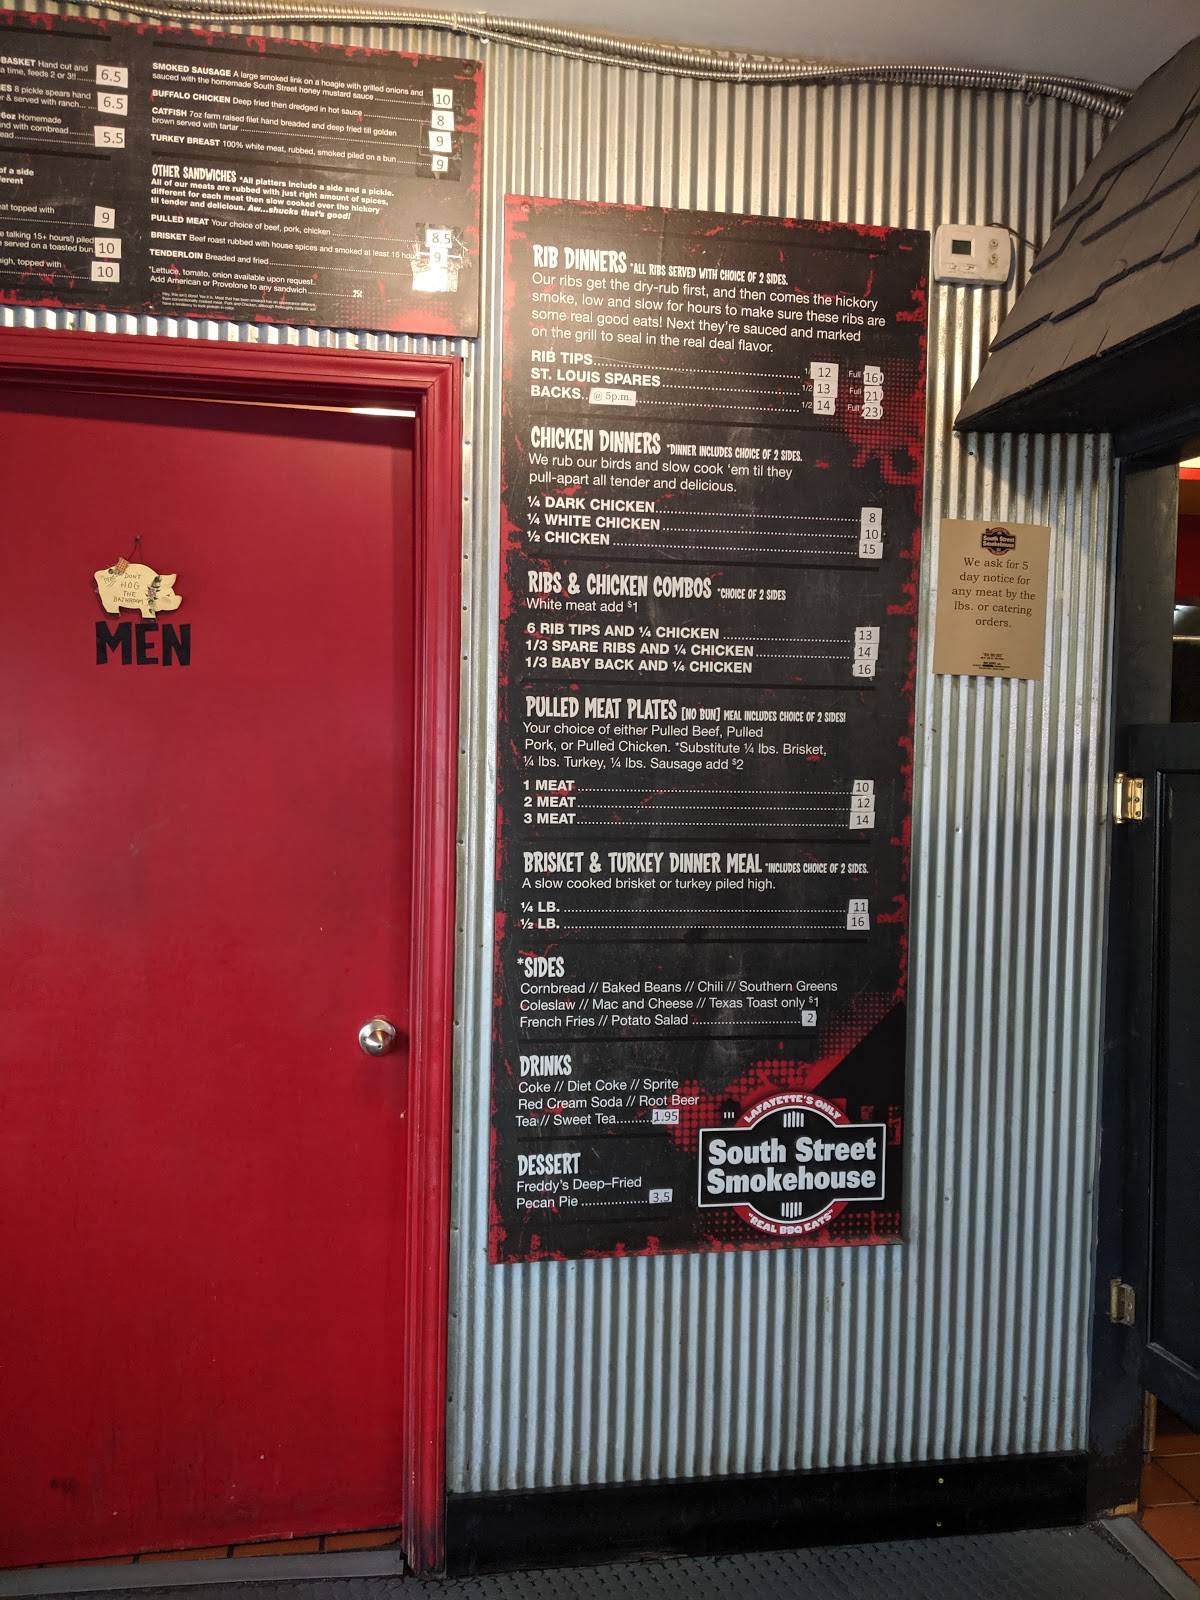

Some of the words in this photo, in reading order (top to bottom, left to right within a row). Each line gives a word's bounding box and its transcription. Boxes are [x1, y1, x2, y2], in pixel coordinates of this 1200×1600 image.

[101, 71, 121, 83] 6.5
[153, 63, 189, 72] SMOKED
[192, 66, 231, 77] SAUSAGE
[241, 71, 258, 80] large
[260, 74, 288, 82] smoked
[322, 80, 344, 89] hoagie
[346, 82, 361, 90] with
[363, 83, 384, 93] grilled
[386, 86, 408, 94] onions
[104, 98, 124, 109] 6.5
[436, 95, 450, 105] 10
[438, 116, 444, 126] 8
[104, 132, 123, 144] 5.5
[436, 136, 443, 146] 9
[437, 160, 443, 169] 9
[152, 164, 179, 177] OTHER
[183, 166, 236, 183] SANDWICHES
[256, 178, 286, 187] platters
[289, 181, 317, 189] include
[327, 183, 342, 192] side
[345, 186, 359, 194] and
[368, 188, 394, 197] pickle.
[102, 213, 110, 223] 9
[99, 243, 115, 254] 10
[150, 249, 203, 259] TENDERLOIN
[205, 253, 235, 263] Breaded
[237, 255, 251, 263] and
[253, 257, 269, 265] fried
[533, 244, 558, 268] RIB
[565, 247, 627, 273] DINNERS
[650, 264, 666, 276] RIBS
[668, 265, 696, 278] SERVED
[699, 267, 717, 280] WITH
[720, 271, 745, 282] CHOICE
[747, 273, 757, 283] OF
[759, 273, 764, 283] 2
[766, 274, 788, 285] SIDES.
[98, 266, 113, 278] 10
[531, 350, 555, 363] RIB
[561, 352, 593, 365] TIPS
[531, 368, 552, 380] ST.
[557, 369, 600, 383] LOUIS
[605, 372, 661, 387] SPARES
[818, 368, 831, 377] 12
[865, 373, 877, 383] 16
[531, 385, 581, 399] BACKS
[817, 384, 830, 393] 13
[605, 392, 632, 402] 5p.m.
[865, 391, 877, 401] 21
[817, 401, 830, 410] 14
[865, 407, 878, 417] 23
[531, 426, 593, 451] CHICKEN
[599, 430, 661, 454] DINNERS
[699, 446, 732, 458] INCLUDES
[735, 447, 760, 459] CHOICE
[762, 449, 771, 460] OF
[774, 450, 778, 460] 2
[781, 451, 802, 462] SIDES.
[545, 497, 585, 510] DARK
[590, 499, 655, 513] CHICKEN
[545, 514, 591, 527] WHITE
[596, 516, 660, 530] CHICKEN
[869, 513, 876, 523] 8
[545, 531, 610, 545] CHICKEN
[865, 529, 878, 539] 10
[862, 544, 876, 554] 15
[964, 557, 980, 567] We
[984, 559, 1002, 568] ask
[1006, 560, 1019, 569] for
[1023, 562, 1028, 570] 5
[960, 572, 980, 584] day
[983, 575, 1014, 583] notice
[1018, 576, 1031, 585] for
[528, 571, 561, 593] RIBS
[568, 572, 580, 594] &
[587, 573, 648, 596] CHICKEN
[653, 576, 711, 599] COMBOS
[748, 589, 756, 599] OF
[759, 589, 764, 600] 2
[767, 589, 786, 600] SIDES
[952, 588, 971, 597] any
[976, 589, 1002, 597] meat
[1006, 589, 1017, 600] by
[1020, 590, 1035, 600] the
[954, 601, 973, 611] lbs.
[993, 604, 1032, 616] catering
[976, 618, 1012, 628] orders.
[95, 621, 191, 666] MEN
[526, 696, 579, 718] PULLED
[584, 697, 621, 719] MEAT
[627, 699, 677, 720] PLATES
[681, 707, 696, 721] [NO
[700, 708, 720, 721] BUN]
[724, 711, 742, 721] MEAL
[744, 711, 777, 722] INCLUDES
[779, 711, 804, 722] CHOICE
[806, 711, 814, 722] OF
[817, 712, 822, 723] 2
[825, 712, 846, 723] SIDES!
[524, 852, 584, 873] BRISKET
[589, 851, 601, 873] &
[608, 852, 664, 873] TURKEY
[670, 853, 721, 873] DINNER
[727, 853, 762, 873] MEAL
[803, 863, 827, 873] CHOICE
[829, 863, 838, 873] OF
[841, 863, 845, 873] 2
[848, 863, 869, 874] SIDES.
[538, 902, 560, 912] LB.
[854, 903, 866, 912] 11
[538, 919, 560, 929] LB.
[852, 917, 864, 926] 16
[807, 1013, 813, 1023] 2
[520, 1055, 572, 1077] DRINKS
[744, 1094, 813, 1123] LAFAYETTE'S
[815, 1099, 841, 1119] ONLY
[655, 1111, 677, 1122] 1.95
[709, 1138, 786, 1165] South
[796, 1137, 876, 1162] Street
[518, 1153, 581, 1176] DESSERT
[707, 1166, 876, 1194] Smokehouse
[517, 1197, 554, 1209] Pecan
[559, 1196, 578, 1207] Pie
[653, 1192, 670, 1202] 3.5
[780, 1226, 802, 1234] BBQ
